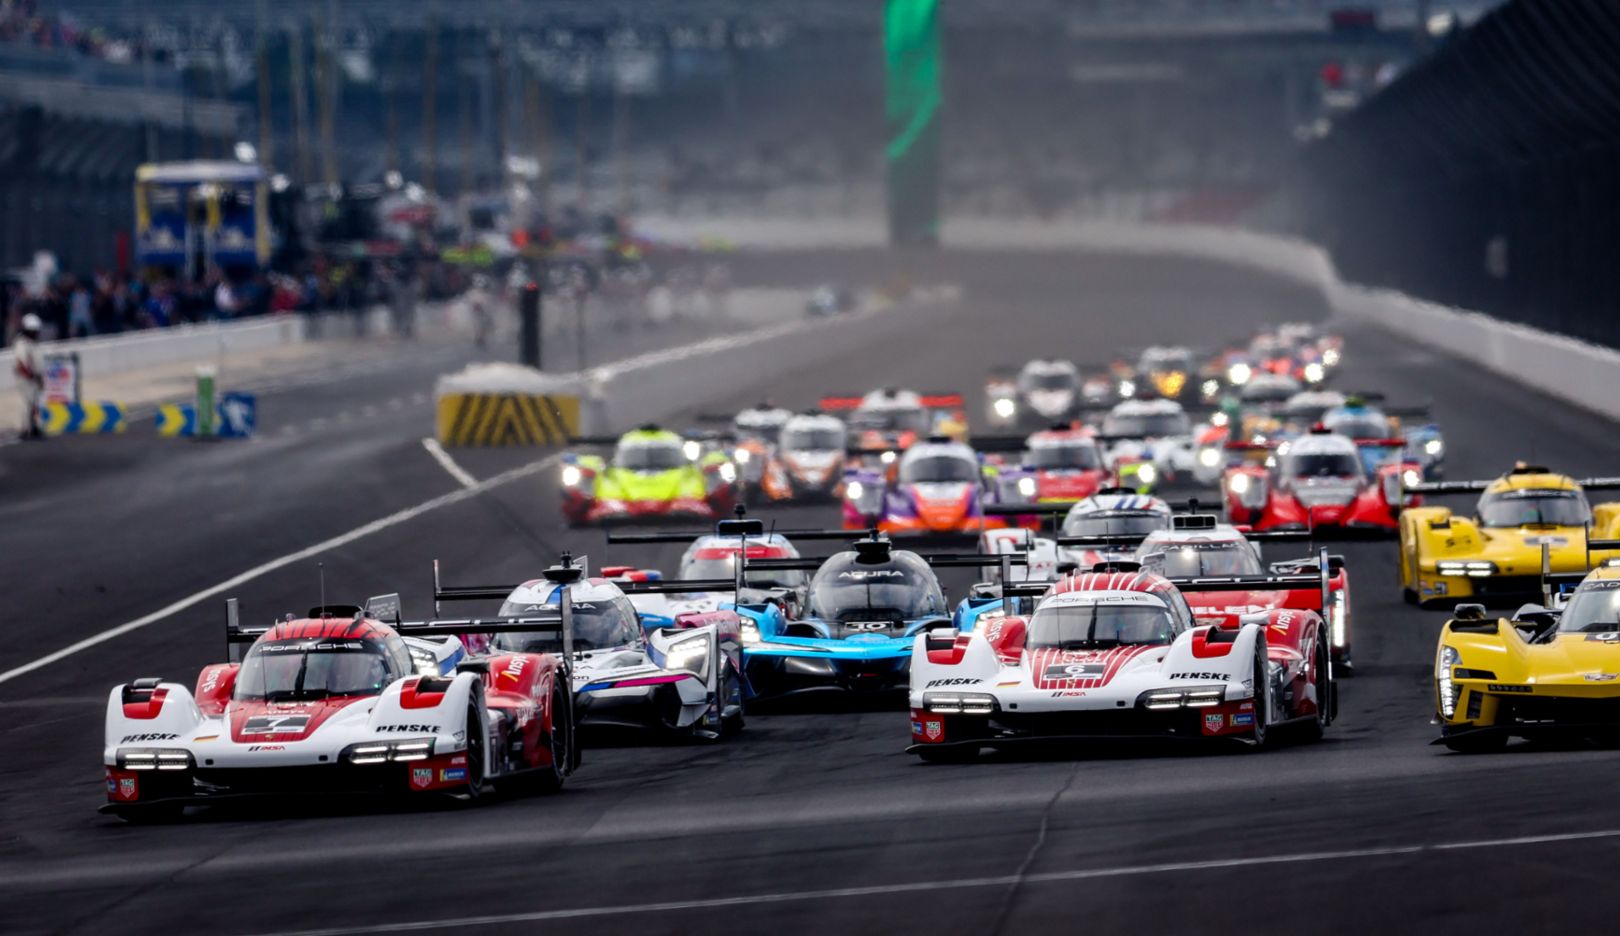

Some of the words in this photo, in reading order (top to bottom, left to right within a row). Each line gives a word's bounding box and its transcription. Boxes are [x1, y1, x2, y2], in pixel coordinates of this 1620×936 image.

[838, 570, 904, 578] ACURA
[259, 642, 362, 652] PORSCHE
[1065, 665, 1085, 675] 6
[1170, 672, 1231, 681] PENSKE
[925, 678, 984, 689] PENSKE
[268, 717, 287, 727] 7
[376, 724, 441, 733] PENSKE
[121, 733, 181, 744] PENSKE
